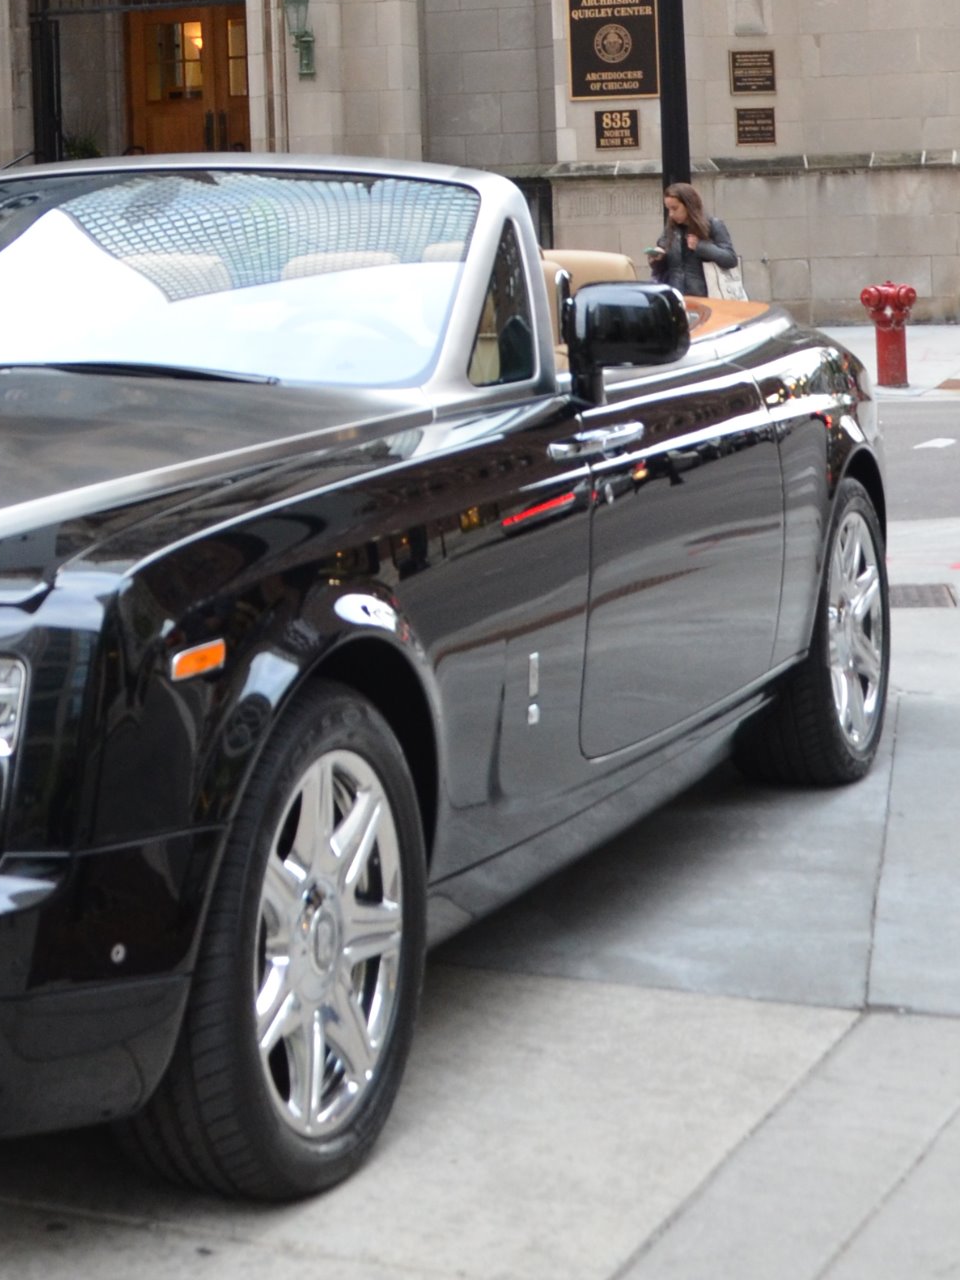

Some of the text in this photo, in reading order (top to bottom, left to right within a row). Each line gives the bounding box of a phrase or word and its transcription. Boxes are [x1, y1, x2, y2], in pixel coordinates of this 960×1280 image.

[571, 6, 652, 20] QUIGLEY CENTER
[585, 71, 643, 81] ARCHDIOCESE
[590, 81, 639, 91] OF CHICAGO
[602, 112, 631, 128] 835
[603, 129, 630, 137] NORTH
[600, 138, 621, 146] RUSH
